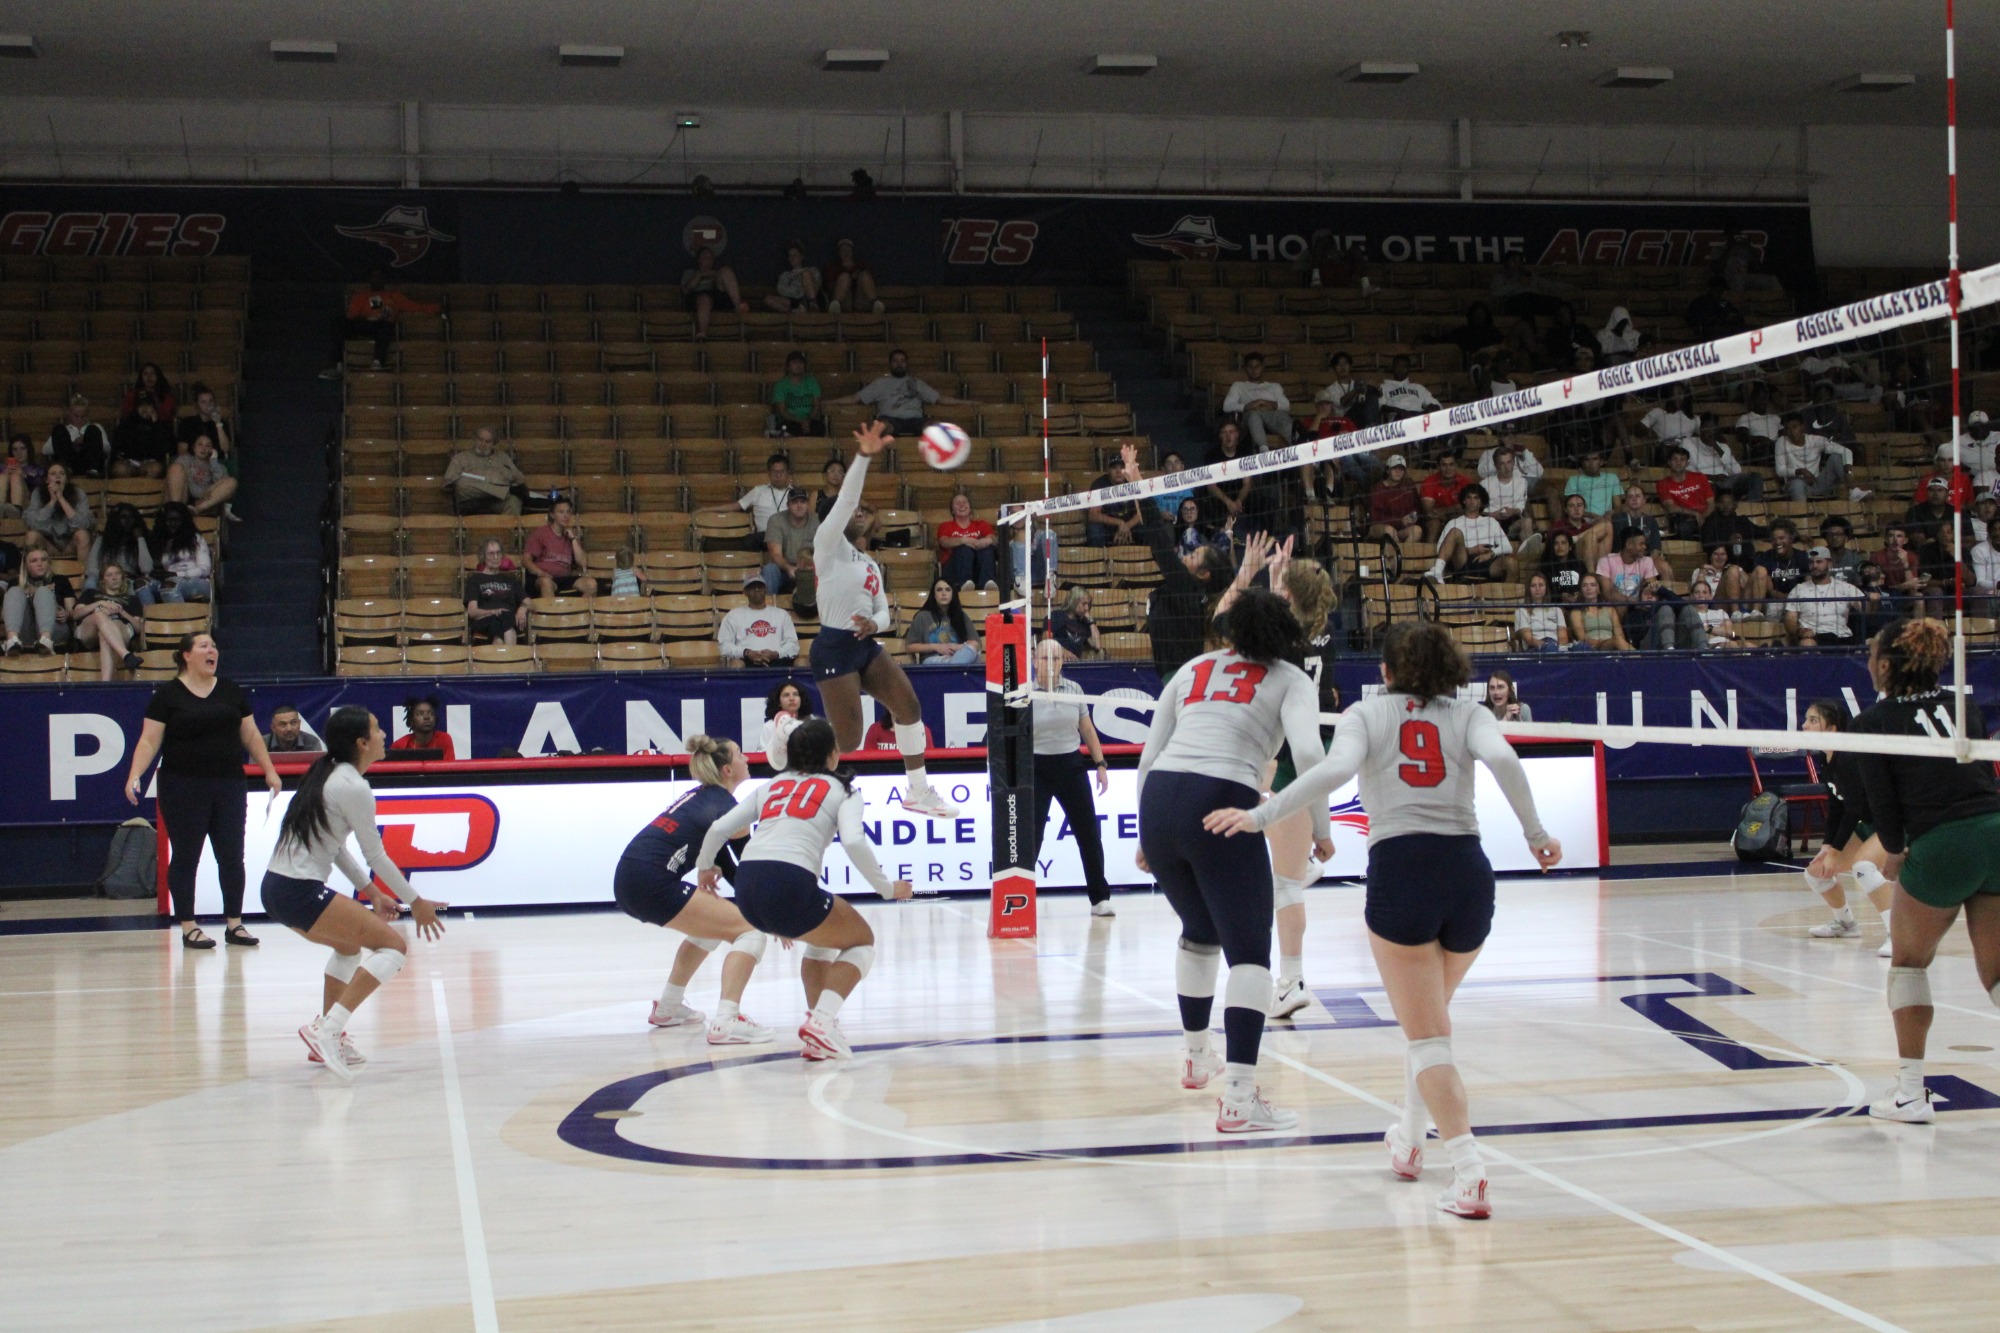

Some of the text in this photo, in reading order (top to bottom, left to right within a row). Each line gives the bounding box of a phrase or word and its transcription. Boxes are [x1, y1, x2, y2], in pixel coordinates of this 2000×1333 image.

[1381, 235, 1436, 262] OF
[1449, 236, 1525, 263] THE
[1796, 307, 1844, 343] AGGIE
[1597, 342, 1720, 391] AGGIE VOLLEYBALL
[1449, 386, 1542, 426] AGGIE VOLLEYBALL
[1333, 420, 1406, 452] AGGIE VOLLEYBALL
[1184, 658, 1269, 706] 13
[1398, 718, 1447, 788] 9
[760, 776, 831, 821] 20
[1007, 794, 1018, 864] sports imports
[1002, 894, 1028, 915] P
